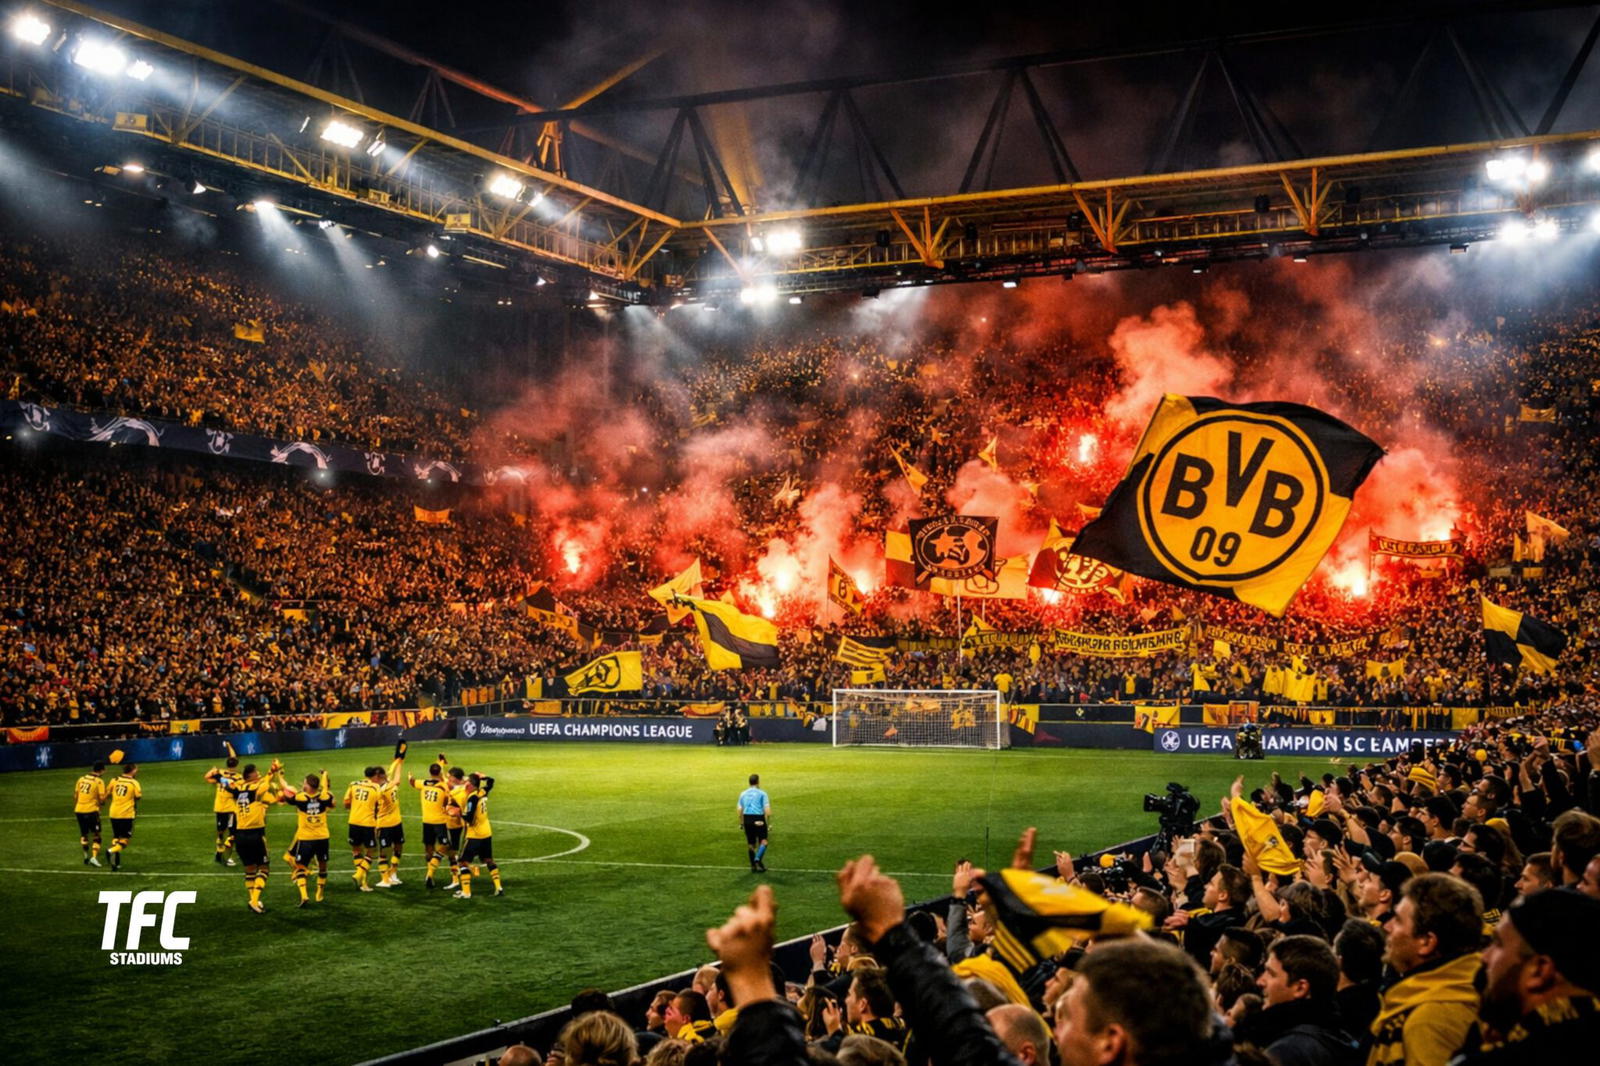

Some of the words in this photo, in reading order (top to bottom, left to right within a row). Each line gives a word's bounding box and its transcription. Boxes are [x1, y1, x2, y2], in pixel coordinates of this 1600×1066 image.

[1161, 430, 1305, 539] BVB
[1190, 526, 1242, 567] 09
[529, 723, 561, 736] UEFA
[564, 723, 640, 737] CHAMPIONS
[643, 724, 693, 738] LEAGUE
[1187, 734, 1233, 750] UEFA
[1258, 735, 1338, 752] HAMPION
